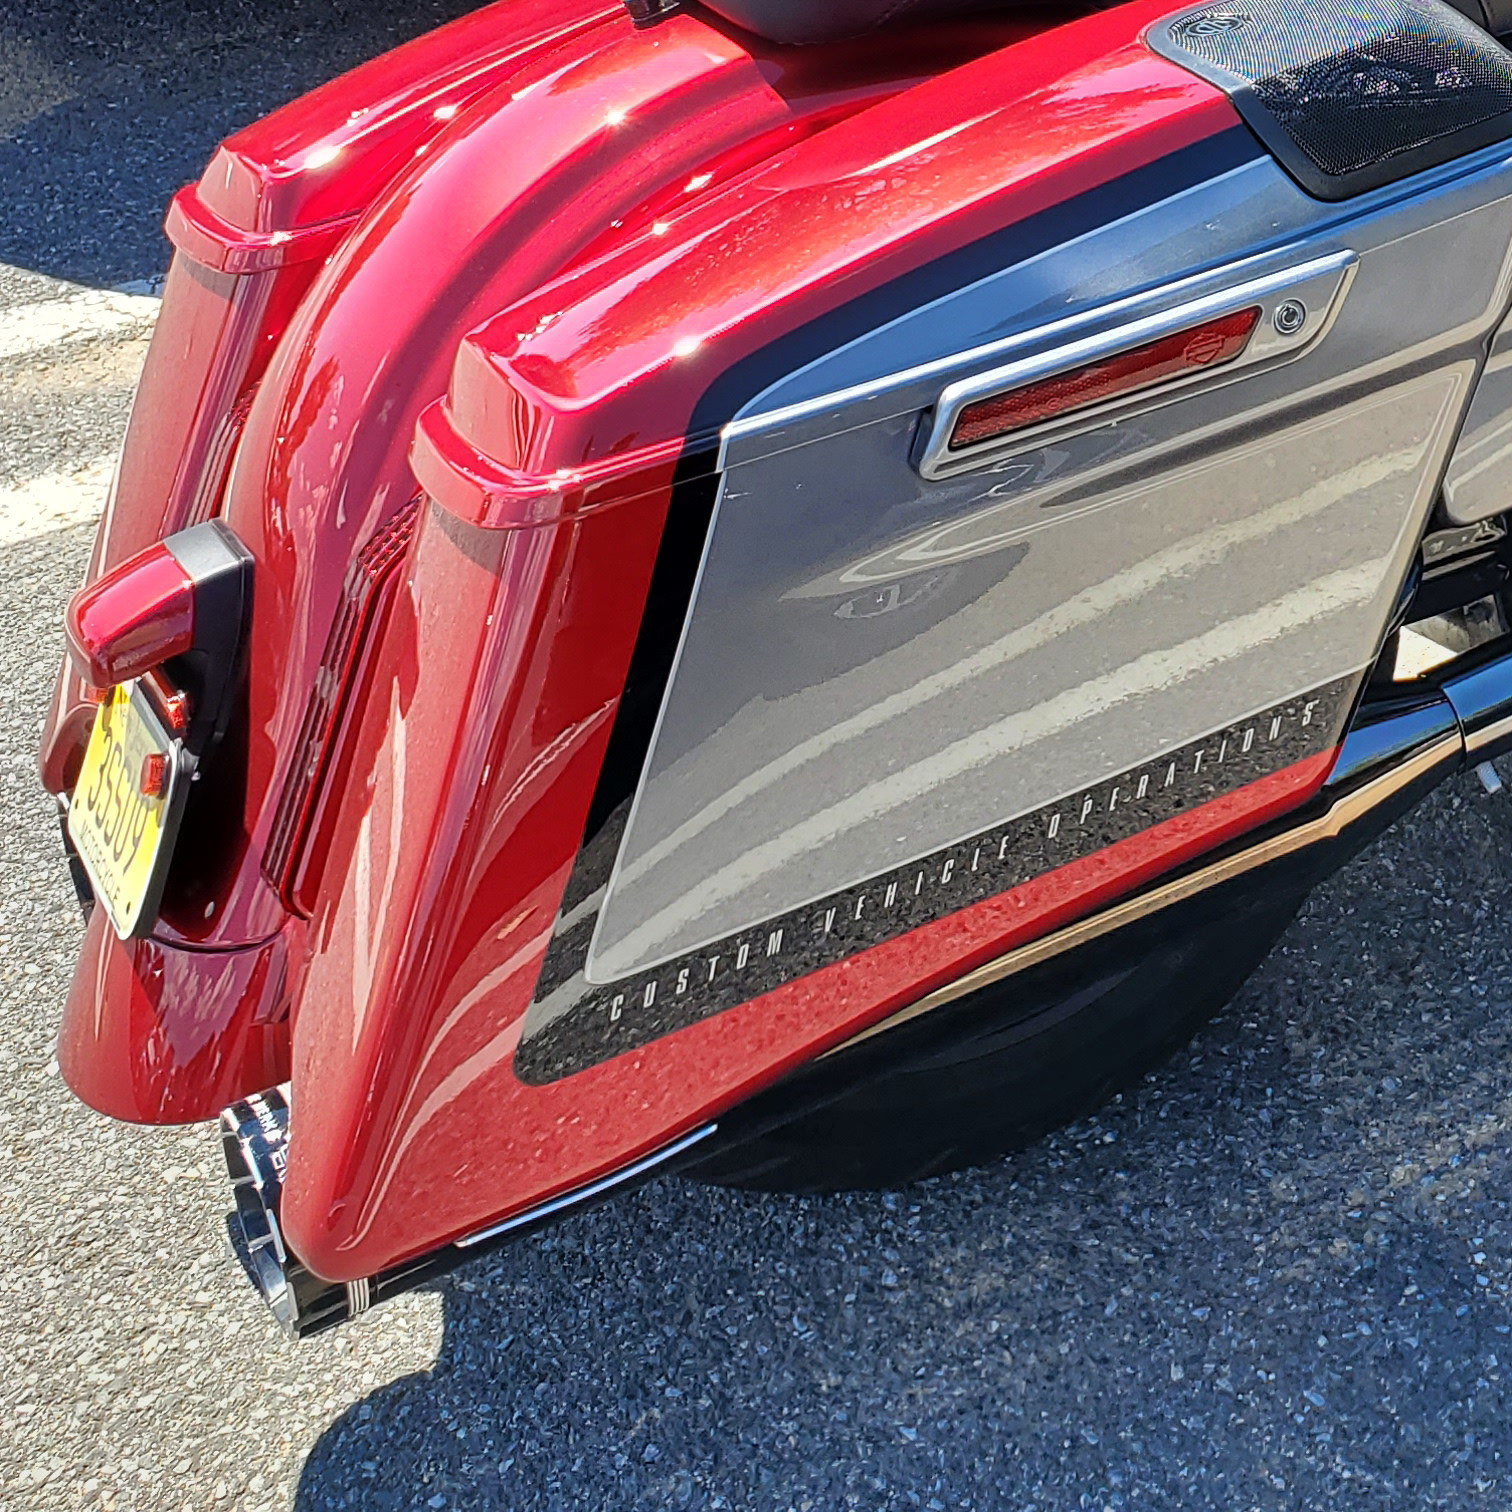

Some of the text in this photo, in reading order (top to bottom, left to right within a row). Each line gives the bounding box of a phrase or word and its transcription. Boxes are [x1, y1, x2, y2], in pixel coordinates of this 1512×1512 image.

[79, 818, 122, 909] MOTORCYCLE
[609, 698, 1321, 1023] CUSTOM VEHICLE OPERATIONS
